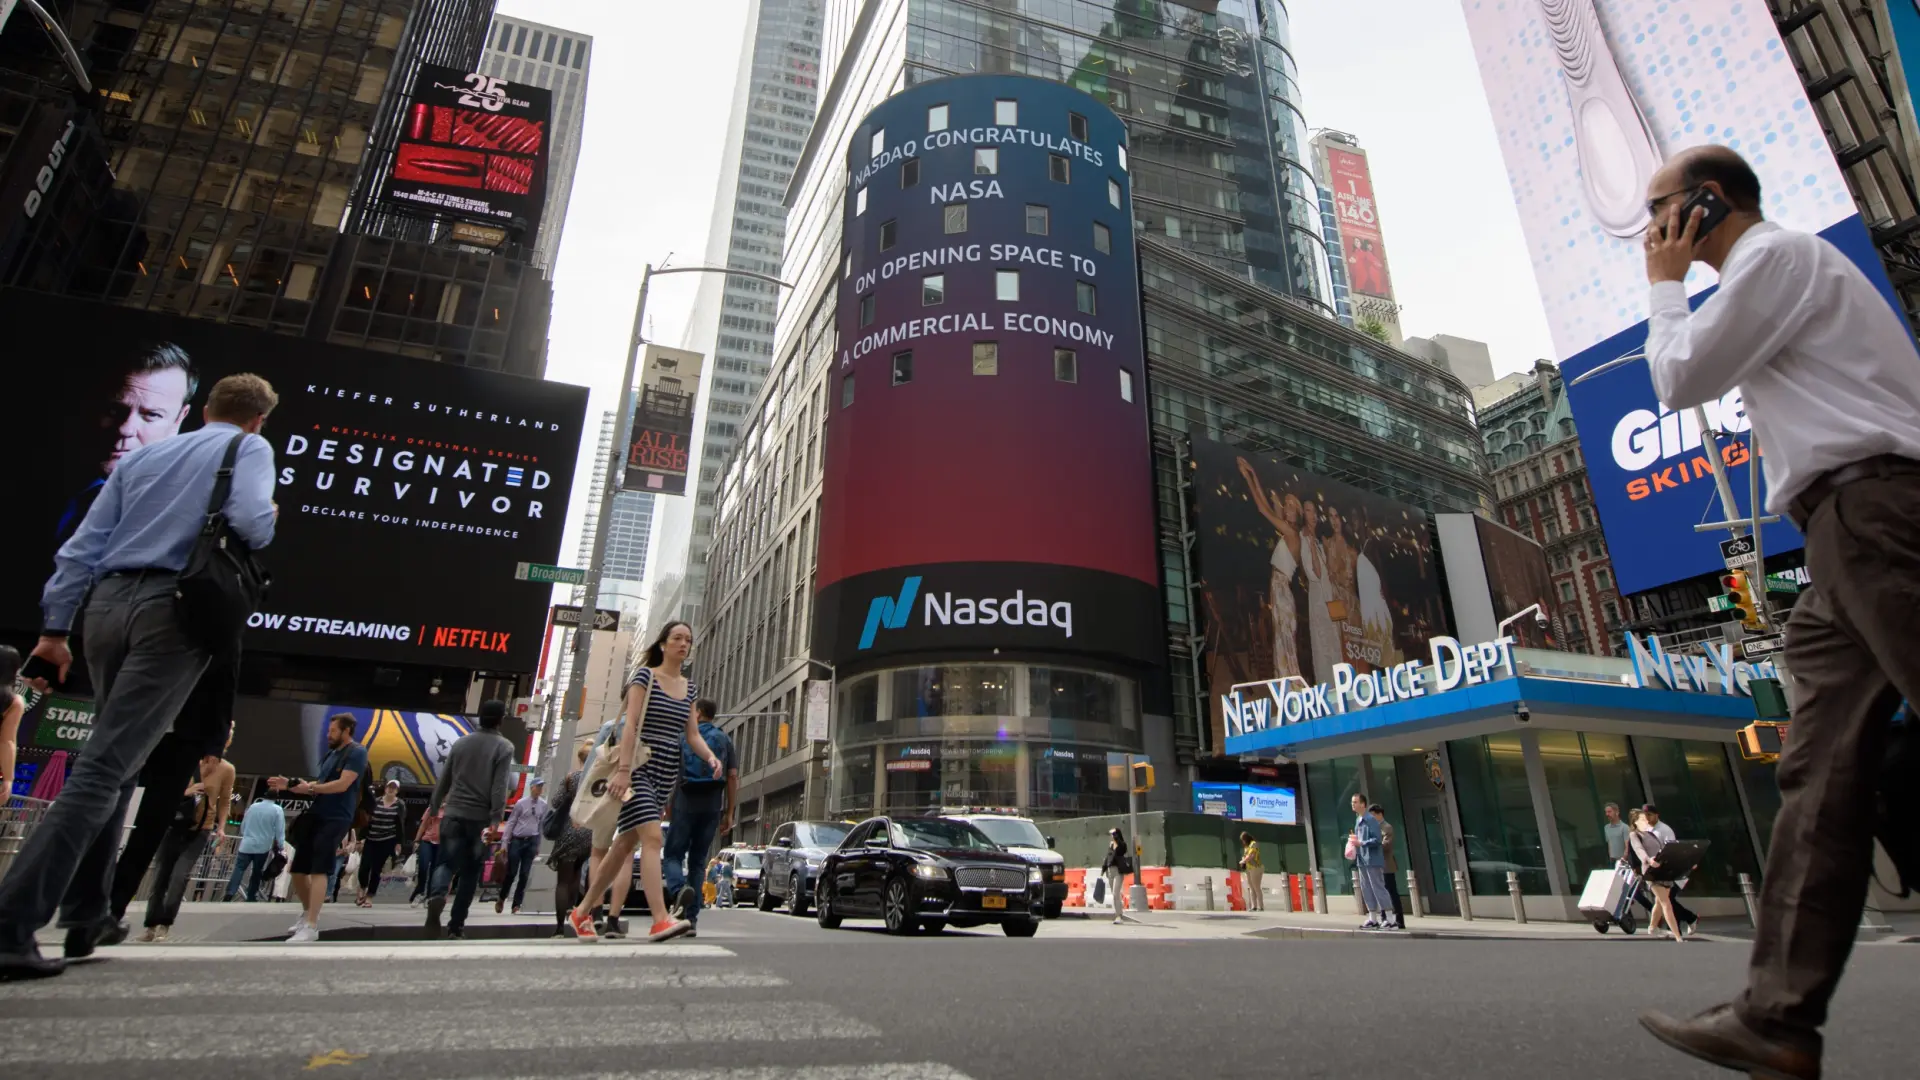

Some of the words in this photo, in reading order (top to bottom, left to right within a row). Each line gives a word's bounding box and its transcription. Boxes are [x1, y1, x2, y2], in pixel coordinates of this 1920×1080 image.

[458, 73, 508, 111] 25
[497, 96, 511, 105] VIVA
[512, 98, 530, 108] GLAM
[854, 140, 917, 188] NASDAQ
[924, 128, 1104, 168] CONGRATULATES
[930, 180, 1004, 205] NASA
[1348, 179, 1357, 195] 1
[393, 190, 408, 199] 1540
[409, 193, 443, 205] BROADWAY
[443, 199, 473, 210] BETWEEN
[474, 205, 490, 214] 45TH
[497, 209, 512, 218] 46TH
[446, 194, 464, 204] TIMES
[465, 197, 490, 208] SQUARE
[1337, 192, 1373, 207] AIRLINE
[1338, 201, 1374, 224] 140
[855, 268, 878, 296] ON
[881, 244, 982, 277] OPENING
[990, 243, 1063, 268] SPACE
[1070, 253, 1097, 277] TO
[841, 349, 851, 370] A
[853, 312, 995, 361] COMMERCIAL
[1004, 312, 1115, 350] ECONOMY
[307, 384, 392, 405] KIEFER
[413, 401, 559, 432] SUTHERLAND
[313, 423, 320, 431] A
[331, 427, 397, 441] NETFLIX
[406, 437, 478, 454] ORIGINAL
[488, 449, 539, 463] SERIES
[636, 429, 685, 452] ALL
[285, 434, 551, 490] DESIGNATED
[629, 444, 688, 471] RISE
[1626, 441, 1763, 501] SKING
[278, 467, 544, 519] SURVIVOR
[301, 505, 365, 520] DECLARE
[373, 514, 409, 526] YOUR
[415, 519, 519, 539] INDEPENDENCE
[1728, 557, 1741, 567] BIKE
[531, 566, 583, 585] Broadway
[1767, 578, 1797, 591] Broadway
[925, 589, 1073, 637] Nasdaq
[1718, 597, 1728, 609] W
[562, 611, 580, 621] ONE
[246, 611, 290, 629] OW
[287, 614, 411, 641] STREAMING
[434, 626, 511, 654] NETFLIX
[1342, 621, 1363, 636] Dress
[1748, 642, 1764, 651] ONE
[1772, 638, 1785, 647] WA
[1222, 691, 1270, 737] NEW
[1267, 679, 1334, 727] YORK
[1332, 660, 1427, 713] POLICE
[1429, 635, 1517, 692] DEPT
[516, 703, 529, 717] P
[910, 748, 931, 756] Nasdaq
[1053, 750, 1075, 759] Nasdaq
[1256, 797, 1275, 807] Turning
[1275, 798, 1288, 807] Point
